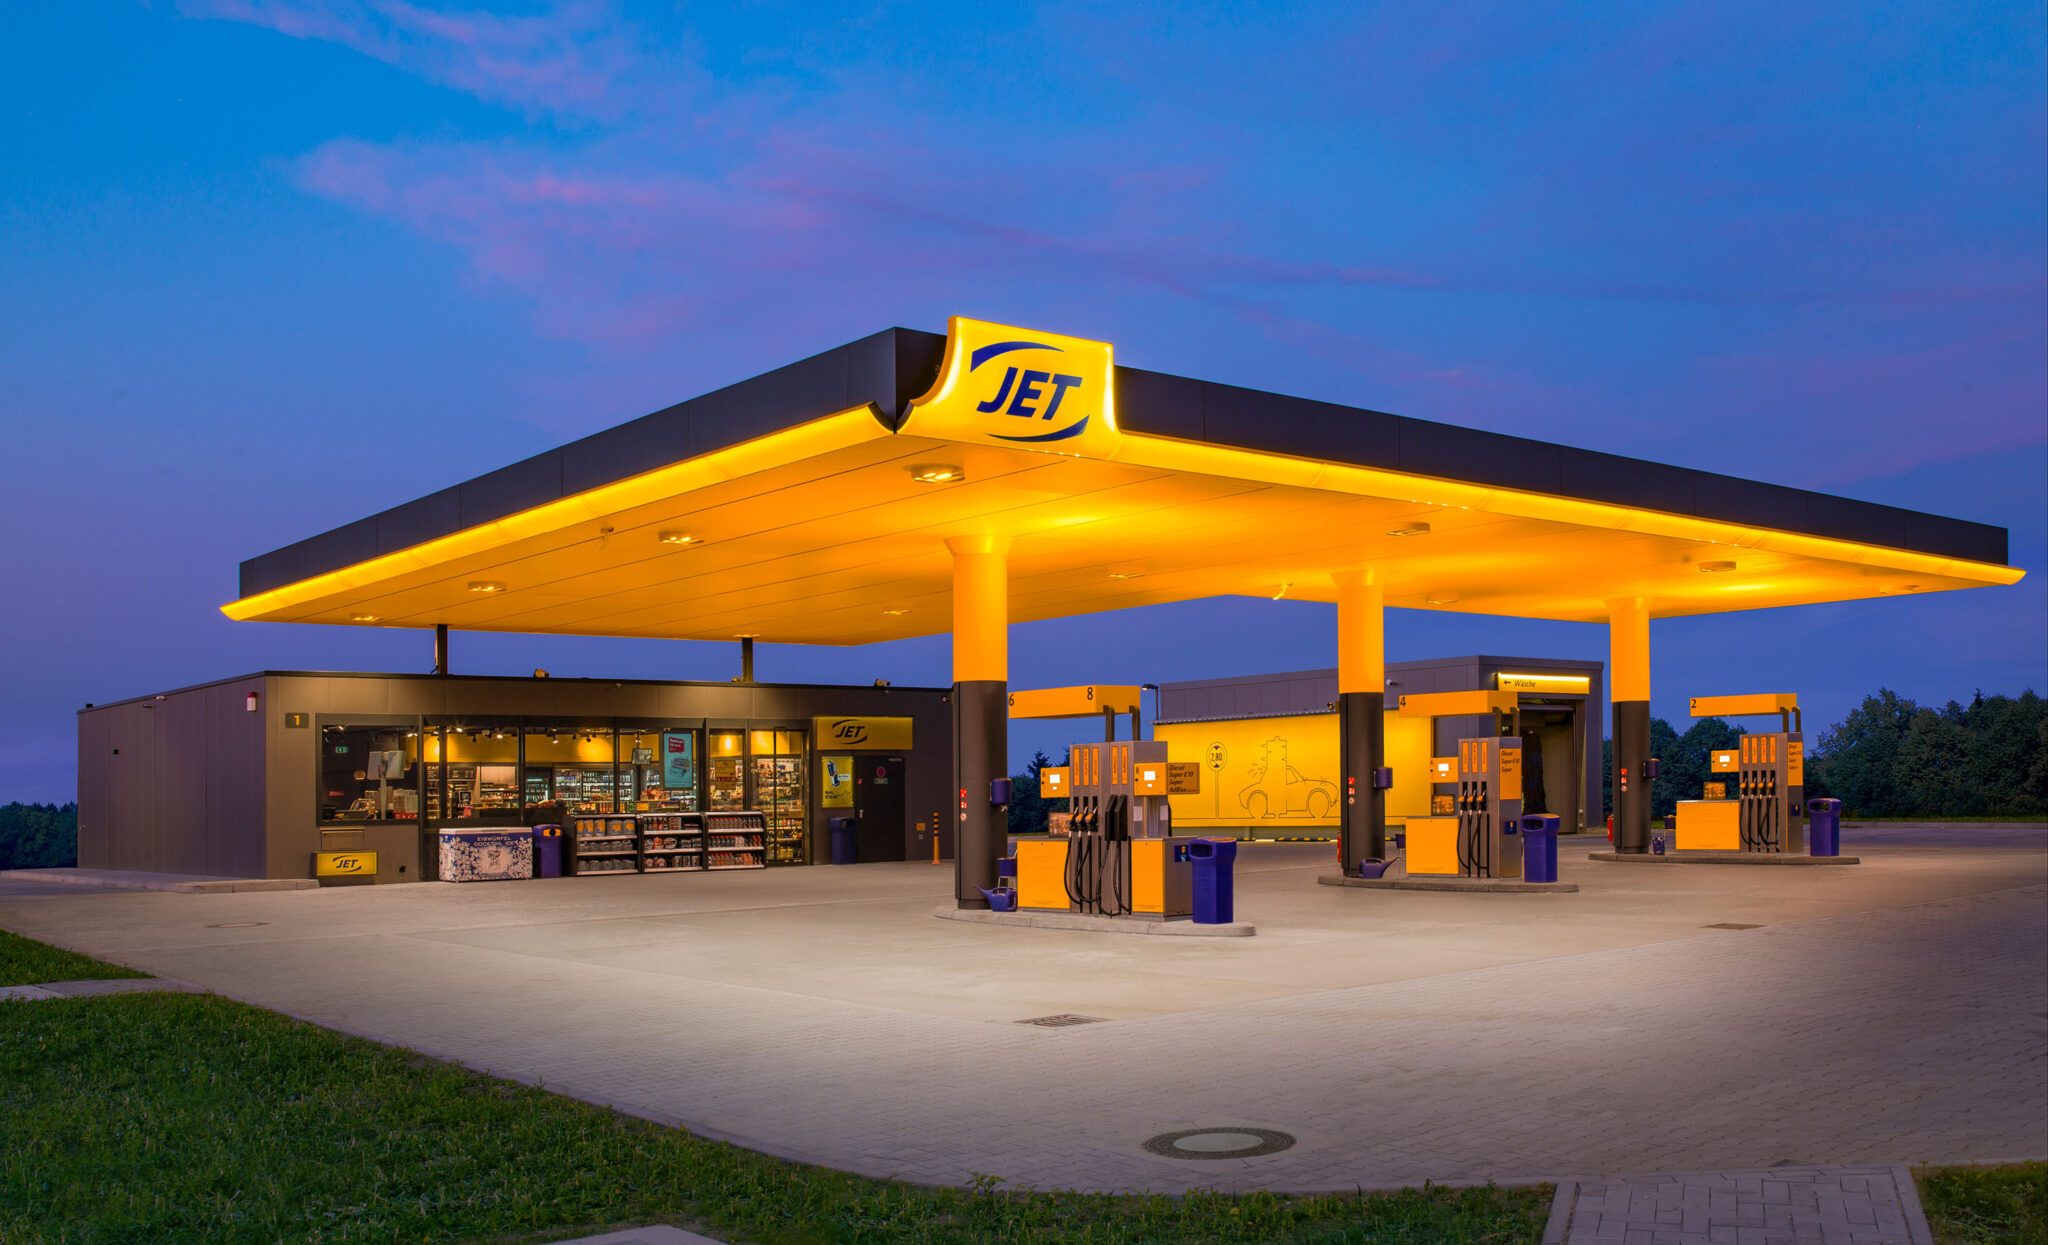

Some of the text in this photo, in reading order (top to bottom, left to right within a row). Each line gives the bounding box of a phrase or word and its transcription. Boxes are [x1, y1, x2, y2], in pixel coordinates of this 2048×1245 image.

[976, 366, 1083, 421] JET
[1008, 693, 1015, 706] 6
[1087, 686, 1094, 701] 8
[1400, 696, 1406, 708] 4
[1691, 698, 1697, 709] 2
[293, 715, 300, 726] 1
[835, 725, 866, 738] JET
[1135, 766, 1140, 775] 8
[336, 859, 358, 869] JET
